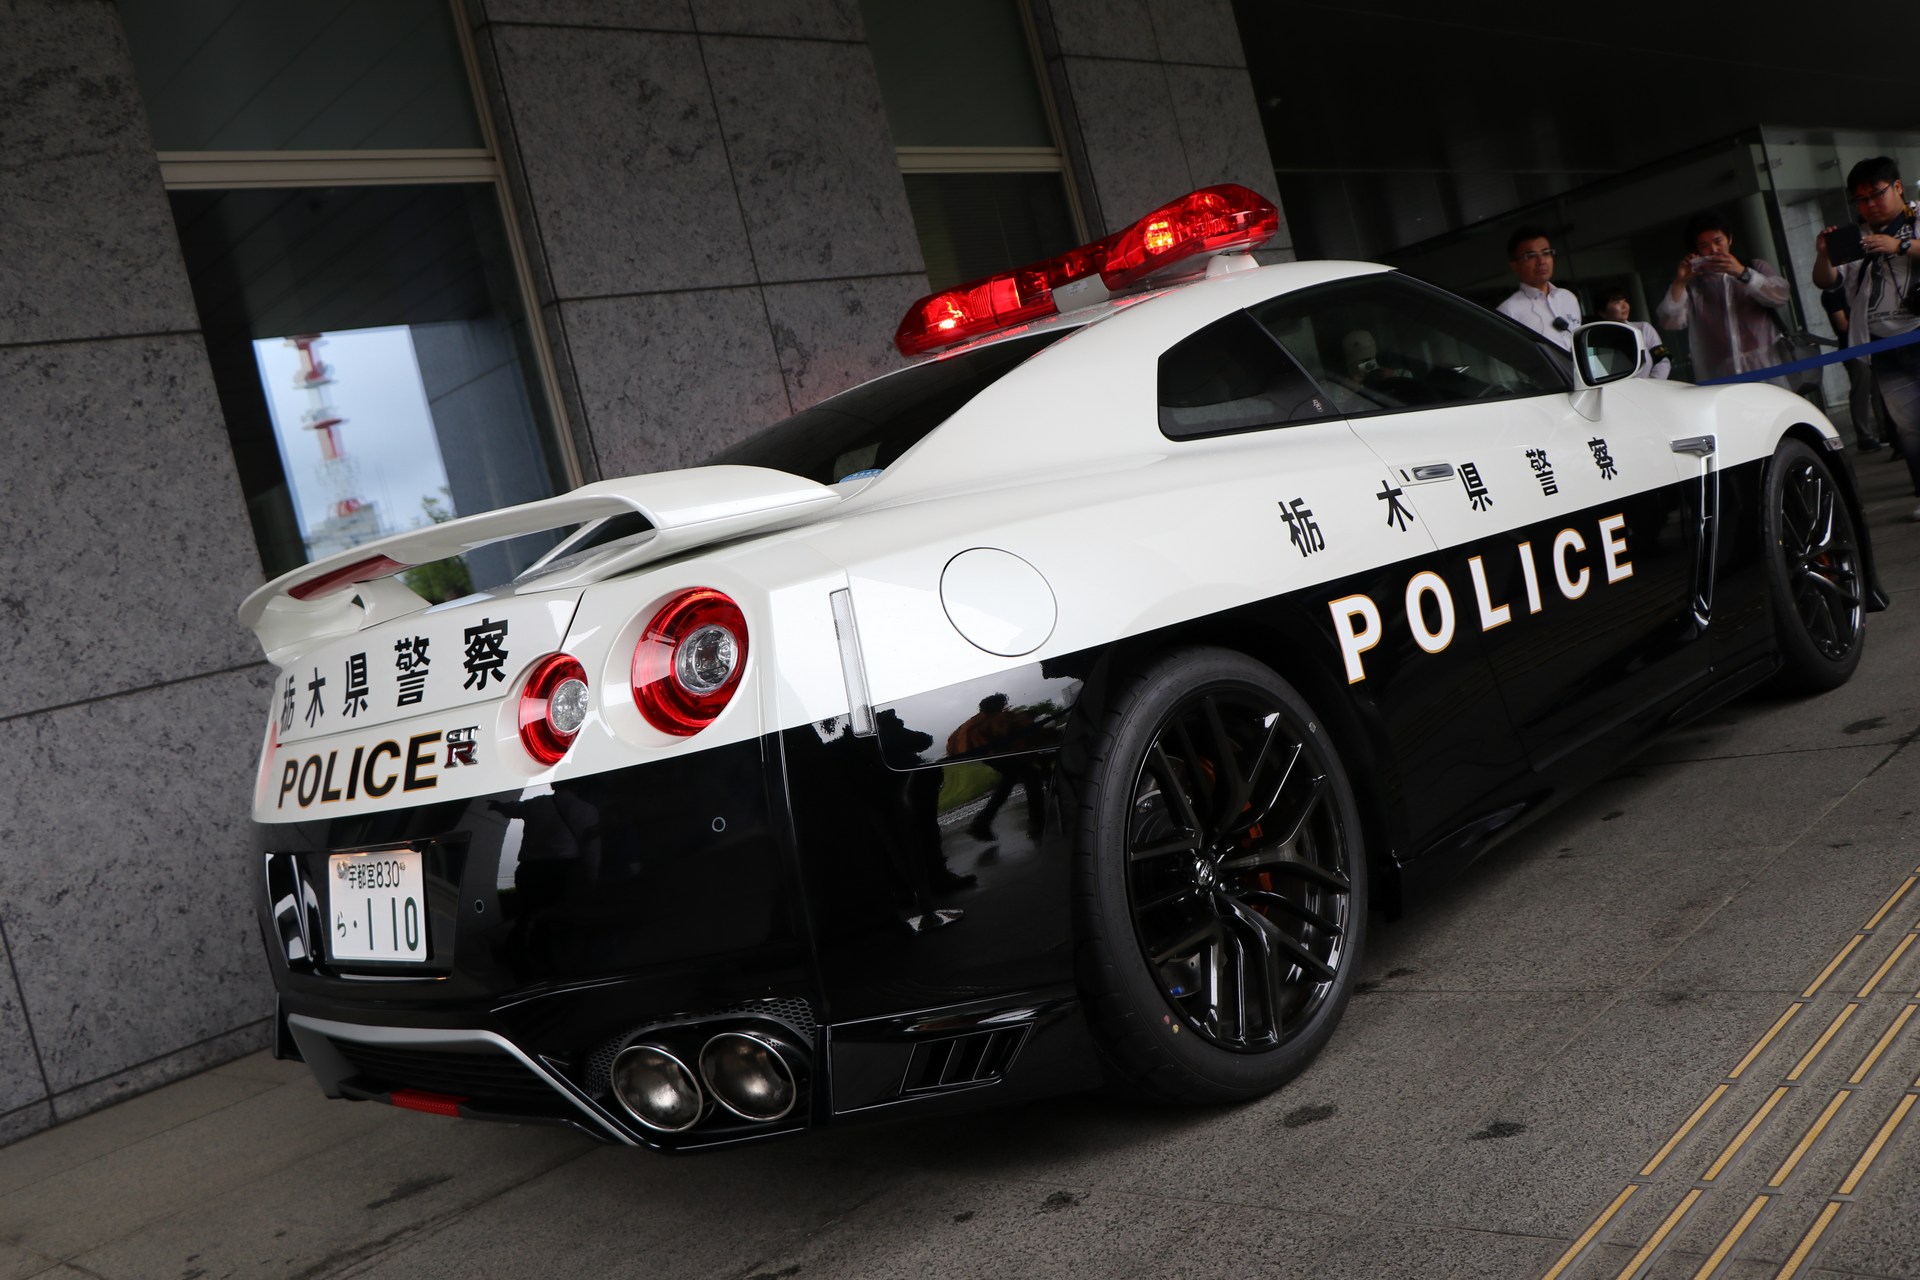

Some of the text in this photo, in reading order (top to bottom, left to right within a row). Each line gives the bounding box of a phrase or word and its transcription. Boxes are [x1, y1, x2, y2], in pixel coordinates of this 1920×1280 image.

[1279, 437, 1618, 558] 栃木県警察
[1328, 513, 1634, 684] POLICE
[279, 617, 509, 736] 栃木県警察
[278, 729, 444, 810] POLICE
